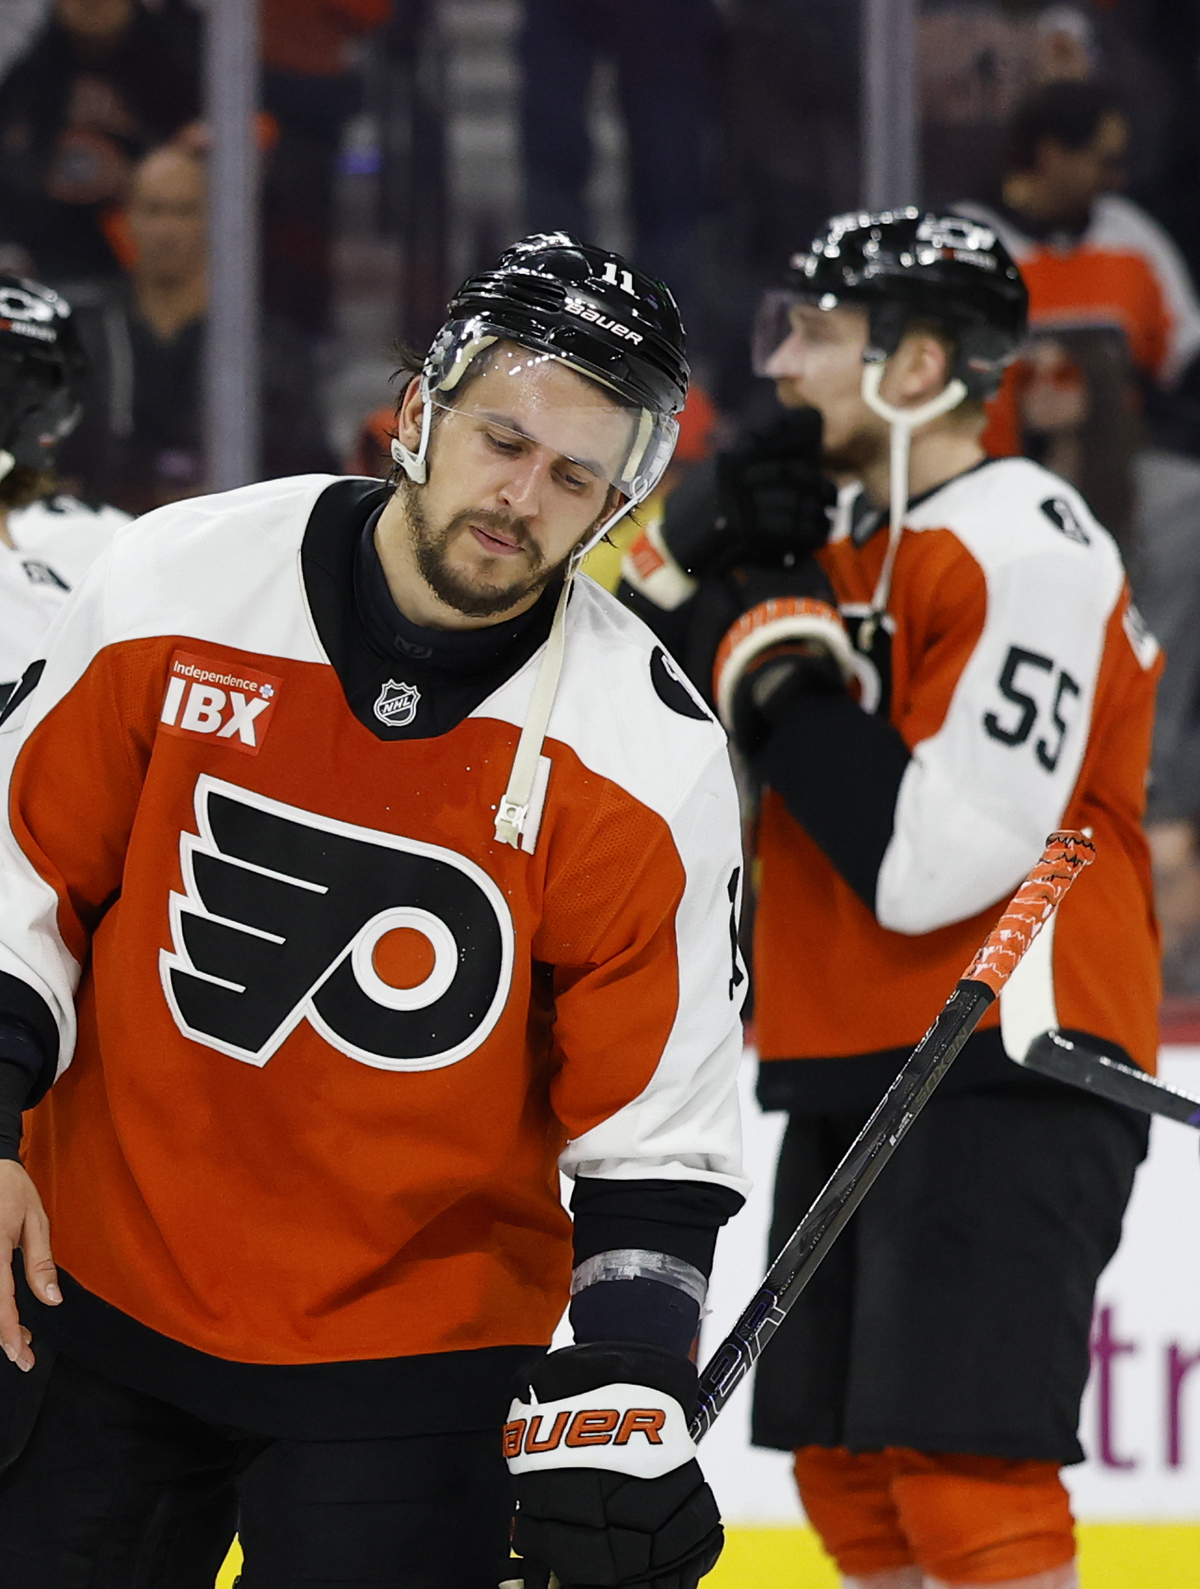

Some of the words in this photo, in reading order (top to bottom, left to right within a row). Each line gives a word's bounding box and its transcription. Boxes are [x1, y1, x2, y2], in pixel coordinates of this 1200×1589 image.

[602, 262, 636, 296] 11
[173, 660, 258, 692] Independence
[160, 676, 271, 748] IBX
[382, 696, 411, 714] NHL
[982, 644, 1081, 773] 55
[502, 1408, 666, 1459] AUER
